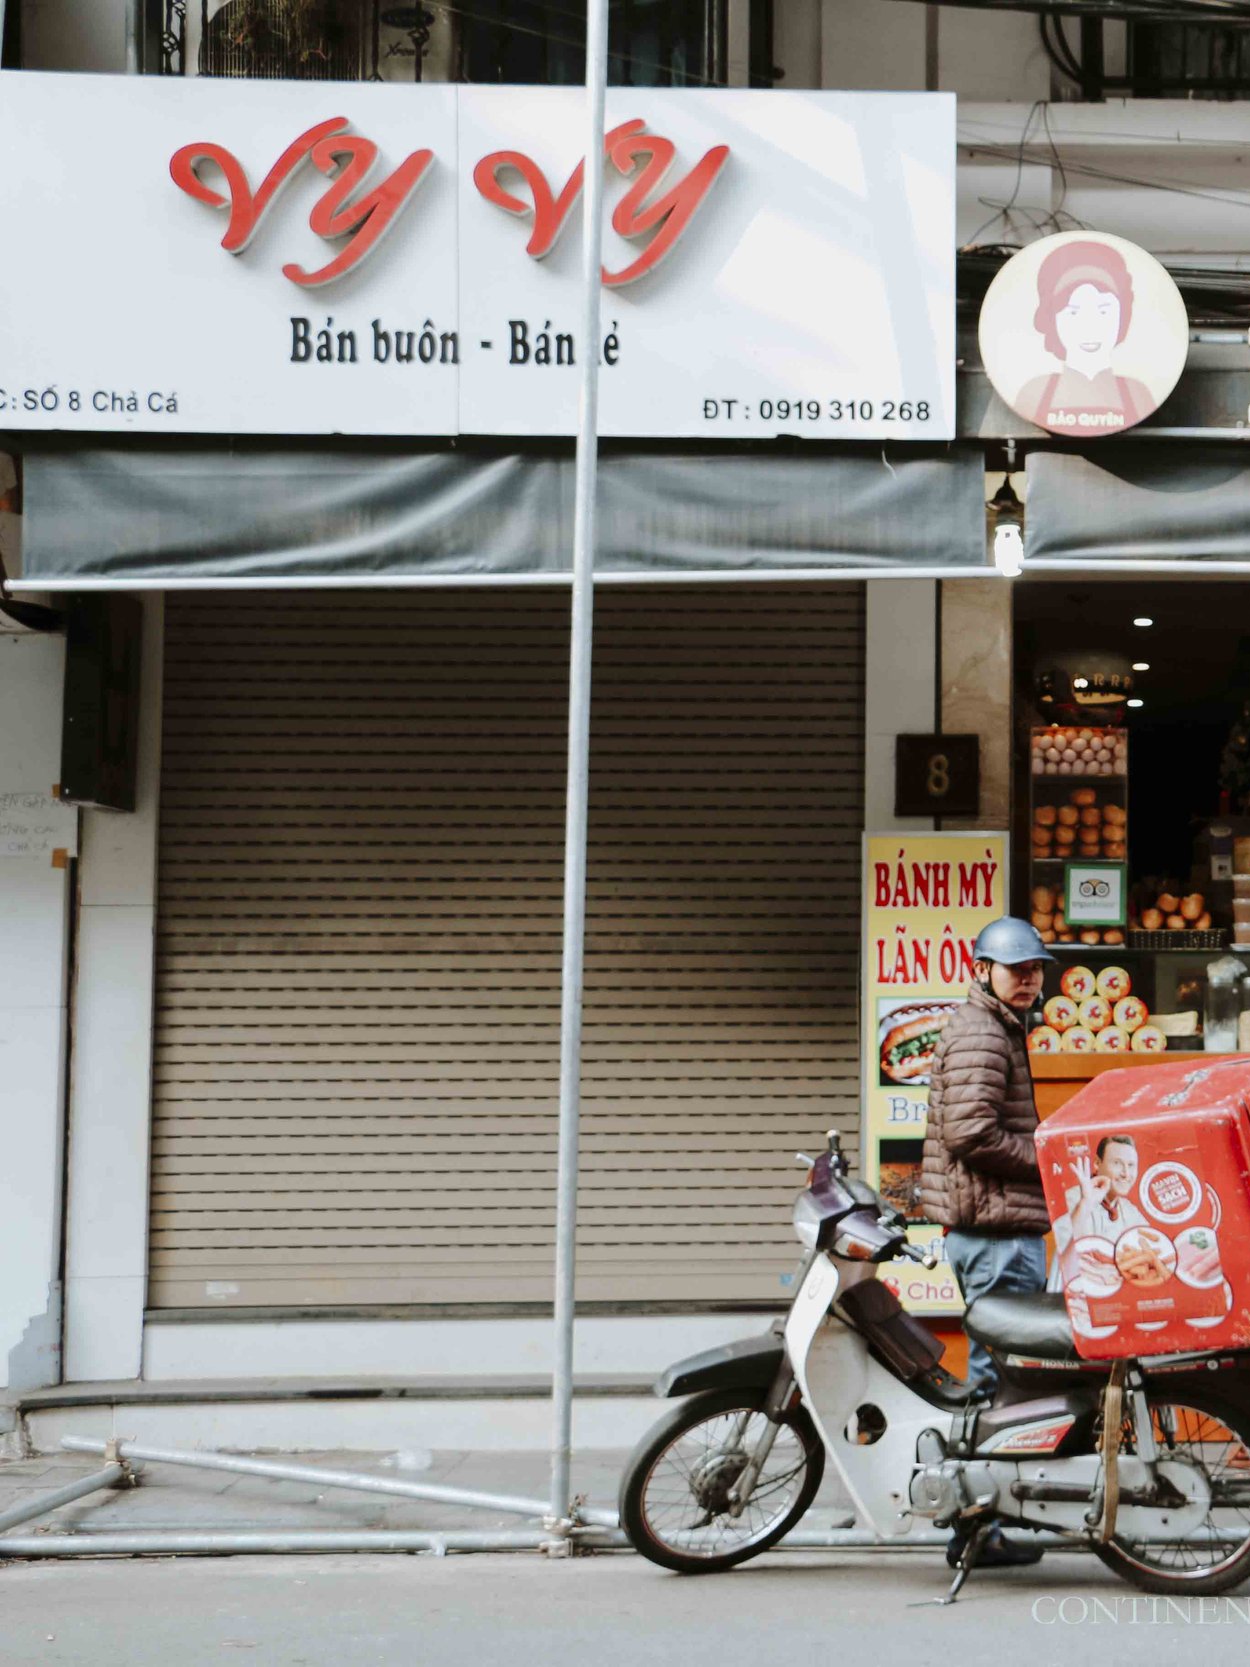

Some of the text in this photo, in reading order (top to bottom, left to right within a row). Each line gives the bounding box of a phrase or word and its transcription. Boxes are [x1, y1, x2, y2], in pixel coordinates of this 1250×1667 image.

[290, 317, 357, 363] Bán
[371, 318, 460, 364] buôn
[508, 320, 575, 366] Bán
[69, 391, 81, 411] 8
[92, 391, 139, 412] Chả
[148, 391, 179, 413] Cá
[759, 400, 821, 421] 0919
[829, 400, 873, 421] 310
[882, 401, 930, 421] 268
[927, 754, 950, 797] 8
[874, 848, 998, 908] BÁNH MỲ
[876, 923, 977, 984] LÃN ÔN
[908, 1279, 955, 1300] Chả
[1041, 1359, 1080, 1370] HONDA
